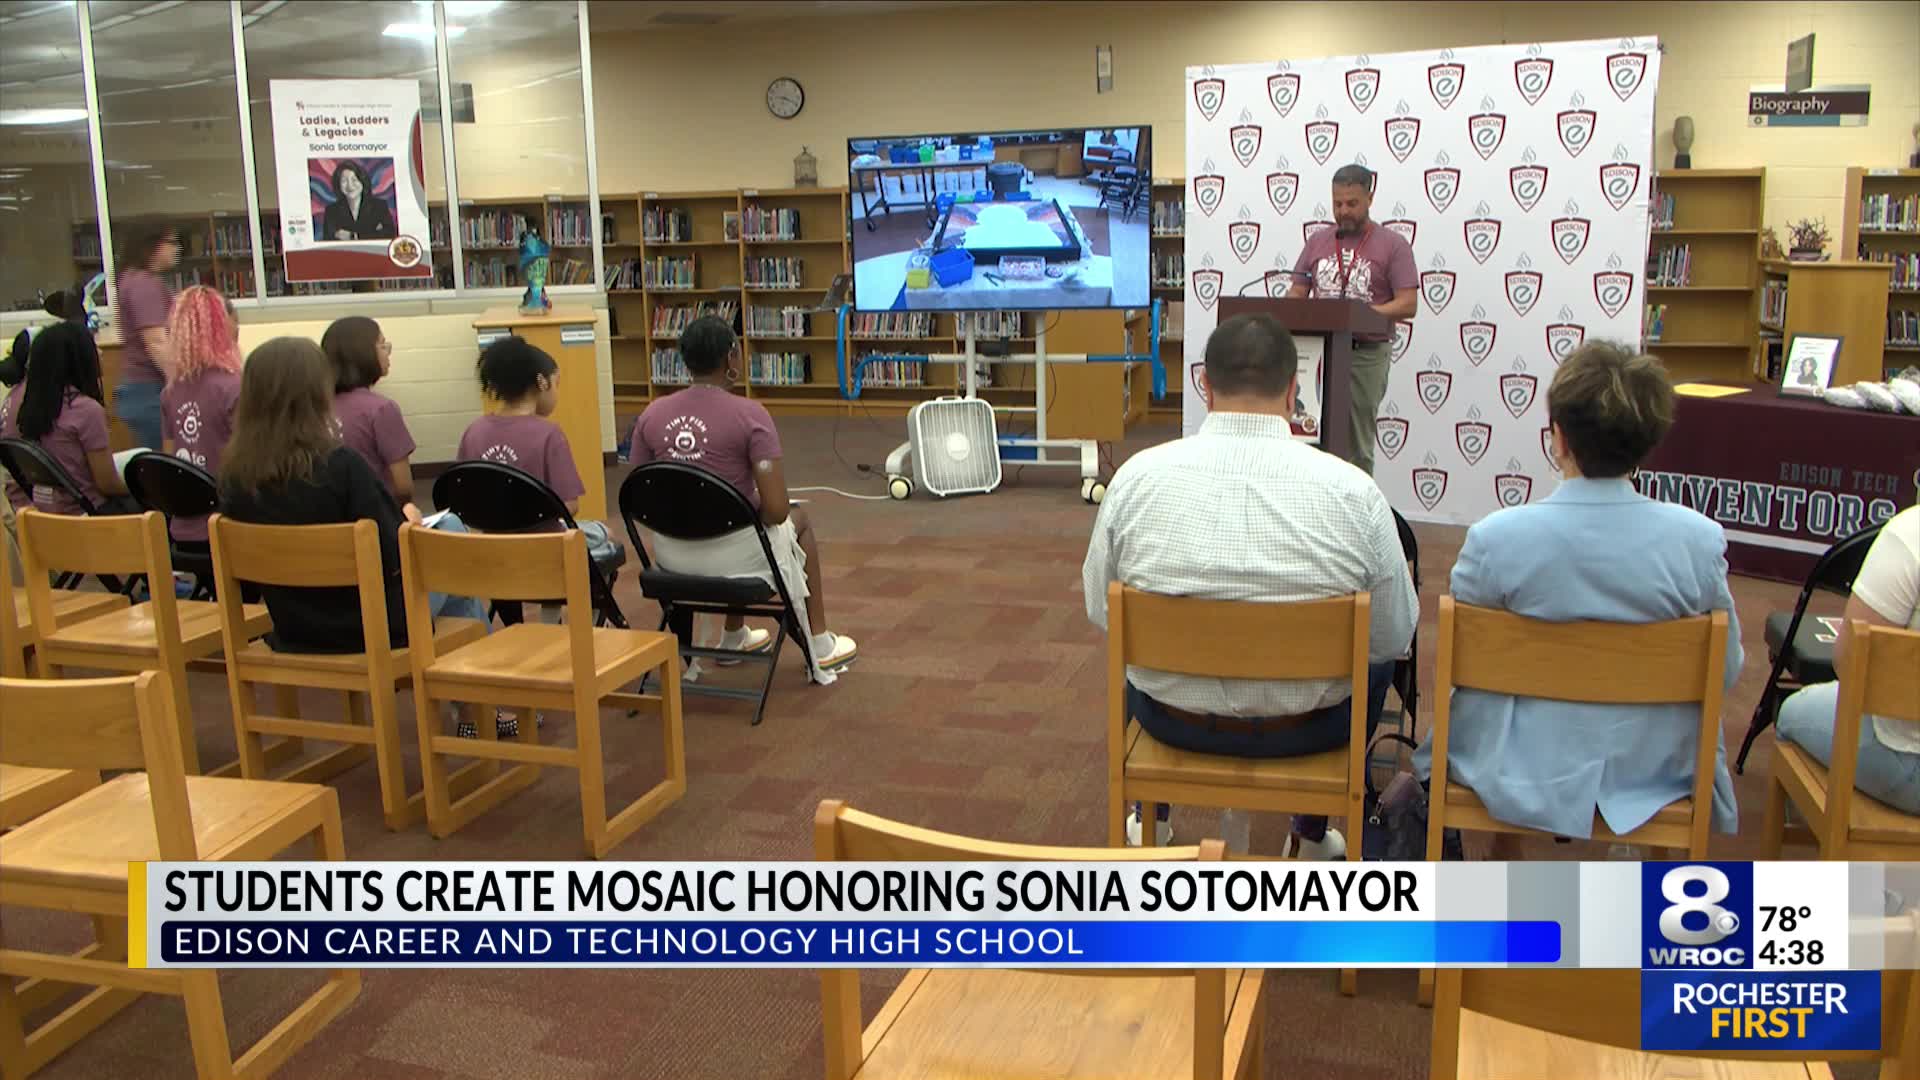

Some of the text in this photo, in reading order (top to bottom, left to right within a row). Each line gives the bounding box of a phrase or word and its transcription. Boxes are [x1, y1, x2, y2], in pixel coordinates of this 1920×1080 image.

[1611, 59, 1641, 68] EDISON
[1519, 64, 1548, 73] EDISON
[1432, 69, 1460, 78] EDISON
[1349, 74, 1375, 83] EDISON
[1271, 79, 1296, 87] EDISON
[1198, 84, 1221, 92] EDISON
[1752, 96, 1830, 114] Biography
[300, 115, 389, 126] Ladies, Ladders
[1473, 119, 1501, 127] EDISON
[1561, 115, 1591, 124] EDISON
[1309, 127, 1334, 135] EDISON
[1388, 123, 1415, 131] EDISON
[302, 127, 364, 139] & Legacies
[1234, 130, 1257, 138] EDISON
[309, 143, 388, 153] Sonia Sotomayor
[1514, 171, 1543, 179] EDISON
[1605, 168, 1635, 177] EDISON
[1428, 173, 1456, 182] EDISON
[1198, 180, 1221, 188] EDISON
[1270, 178, 1295, 186] EDISON
[1232, 226, 1256, 234] EDISON
[1468, 224, 1496, 232] EDISON
[1556, 223, 1585, 232] EDISON
[1196, 274, 1218, 282] EDISON
[1425, 277, 1451, 285] EDISON
[1509, 276, 1538, 285] EDISON
[1599, 277, 1628, 285] EDISON
[1464, 327, 1491, 335] EDISON
[1550, 329, 1580, 337] EDISON
[1420, 376, 1447, 384] EDISON
[1504, 379, 1533, 387] EDISON
[665, 416, 707, 432] TINY FISH
[1460, 427, 1487, 435] EDISON
[481, 444, 500, 461] TINY
[1779, 461, 1899, 495] EDISON TECH
[1499, 480, 1527, 488] EDISON
